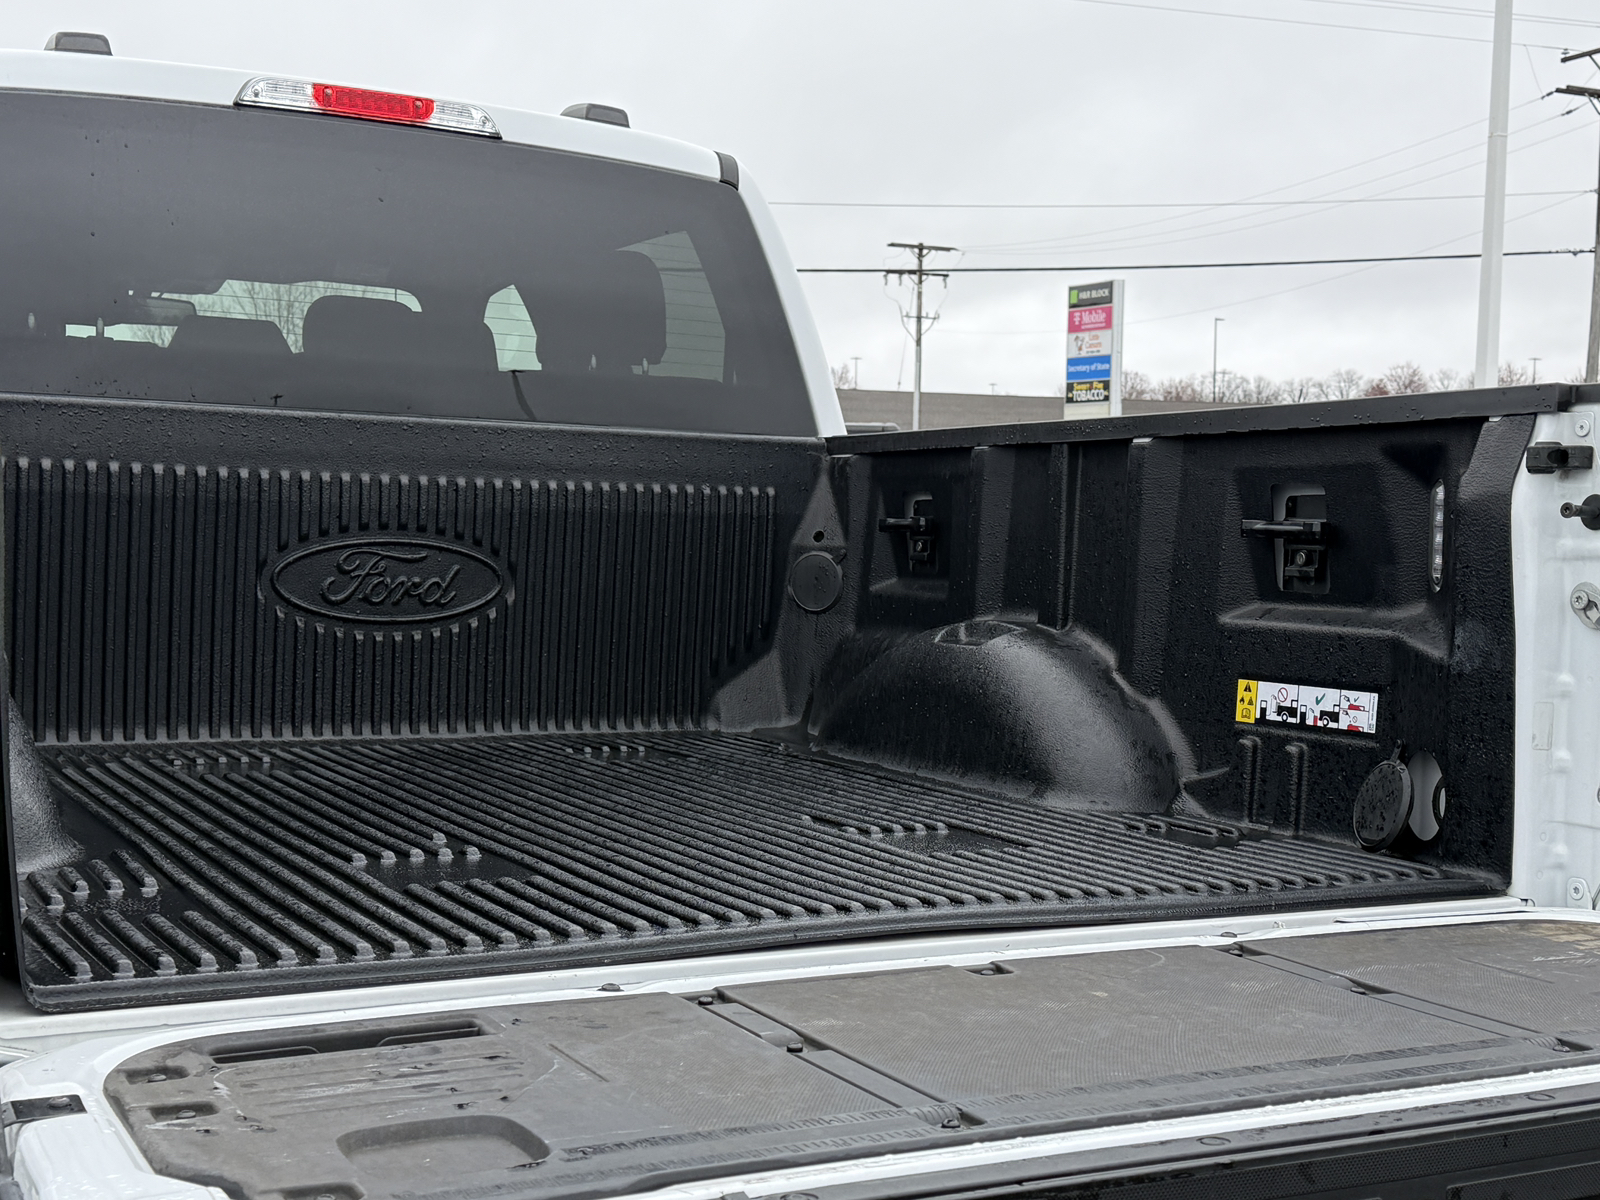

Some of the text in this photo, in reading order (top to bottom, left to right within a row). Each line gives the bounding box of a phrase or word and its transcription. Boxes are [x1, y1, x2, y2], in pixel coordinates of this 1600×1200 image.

[1092, 288, 1109, 298] BLOCK
[1082, 310, 1107, 323] Mobile
[1068, 362, 1110, 373] Secretary of State
[1072, 389, 1104, 402] TOBACCO
[320, 547, 461, 605] Ford
